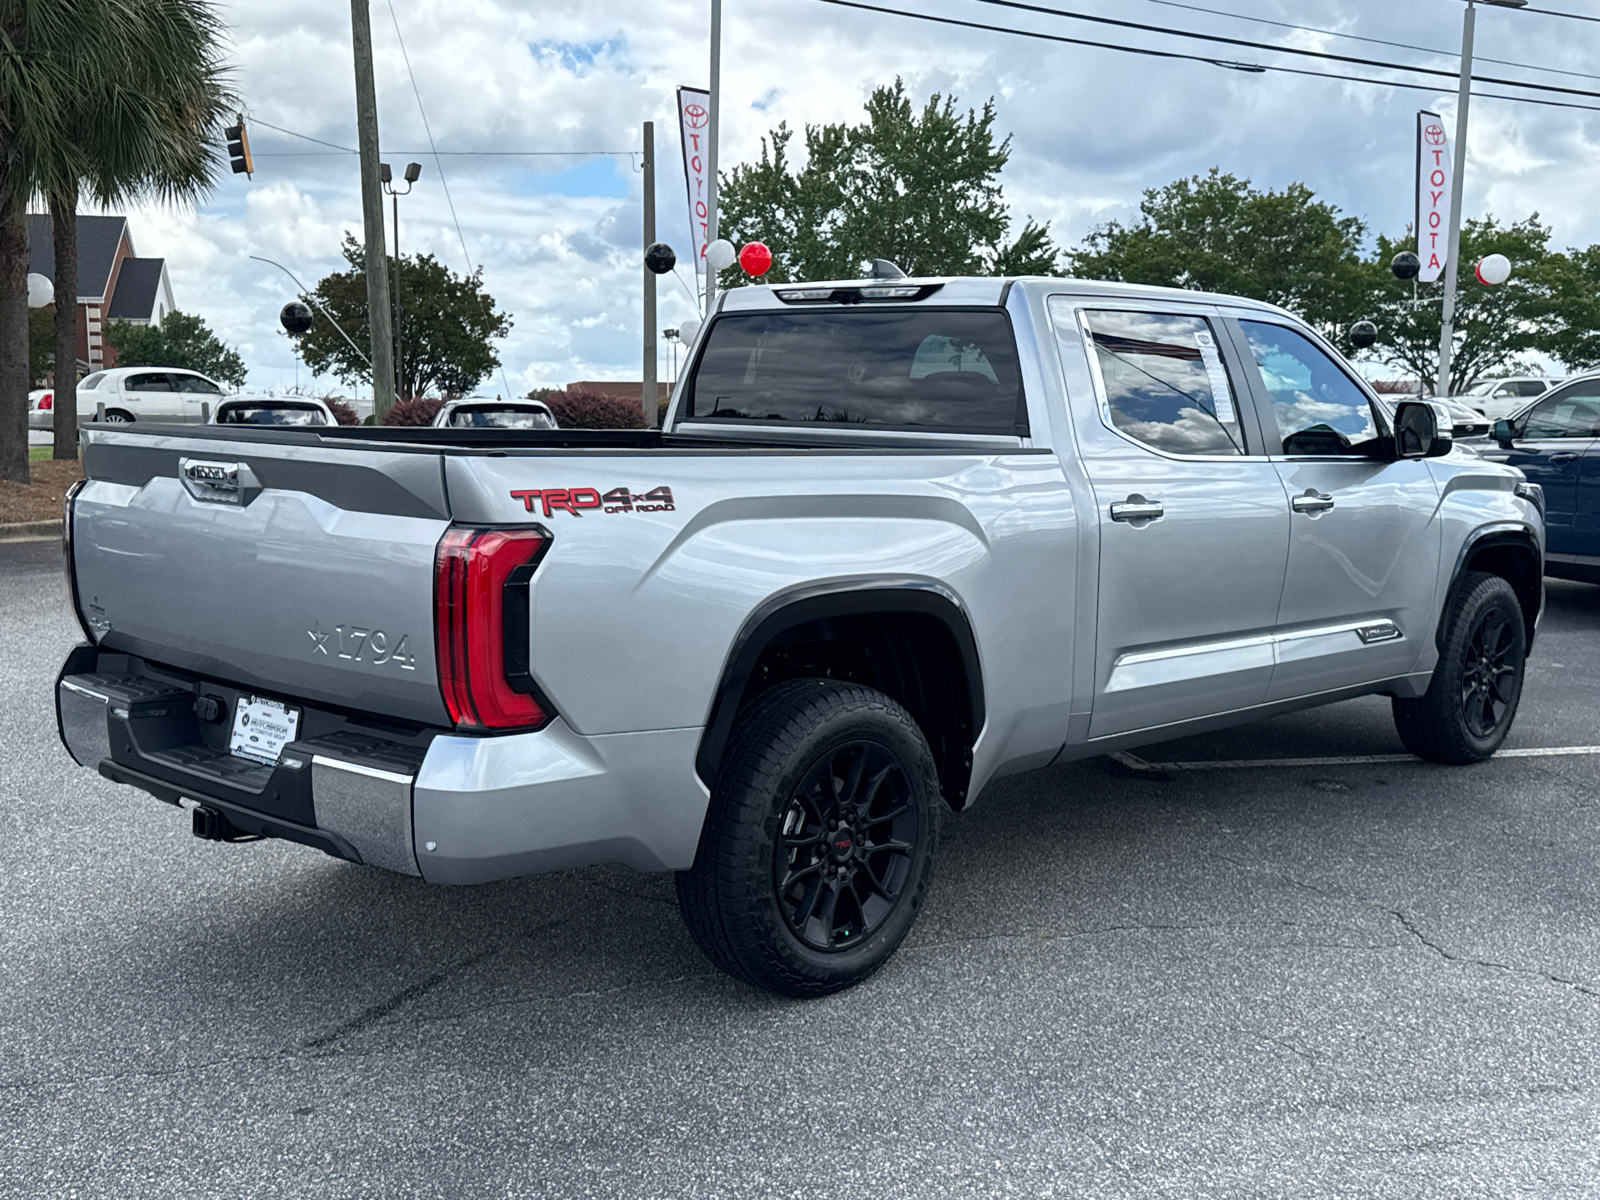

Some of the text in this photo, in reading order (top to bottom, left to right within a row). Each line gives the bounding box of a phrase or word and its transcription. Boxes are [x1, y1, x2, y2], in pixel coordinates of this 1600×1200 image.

[1427, 150, 1445, 269] TOYOTA
[510, 487, 602, 518] TRD
[604, 503, 676, 514] OFF ROAD
[336, 624, 415, 670] 1794
[835, 839, 852, 849] TRD
